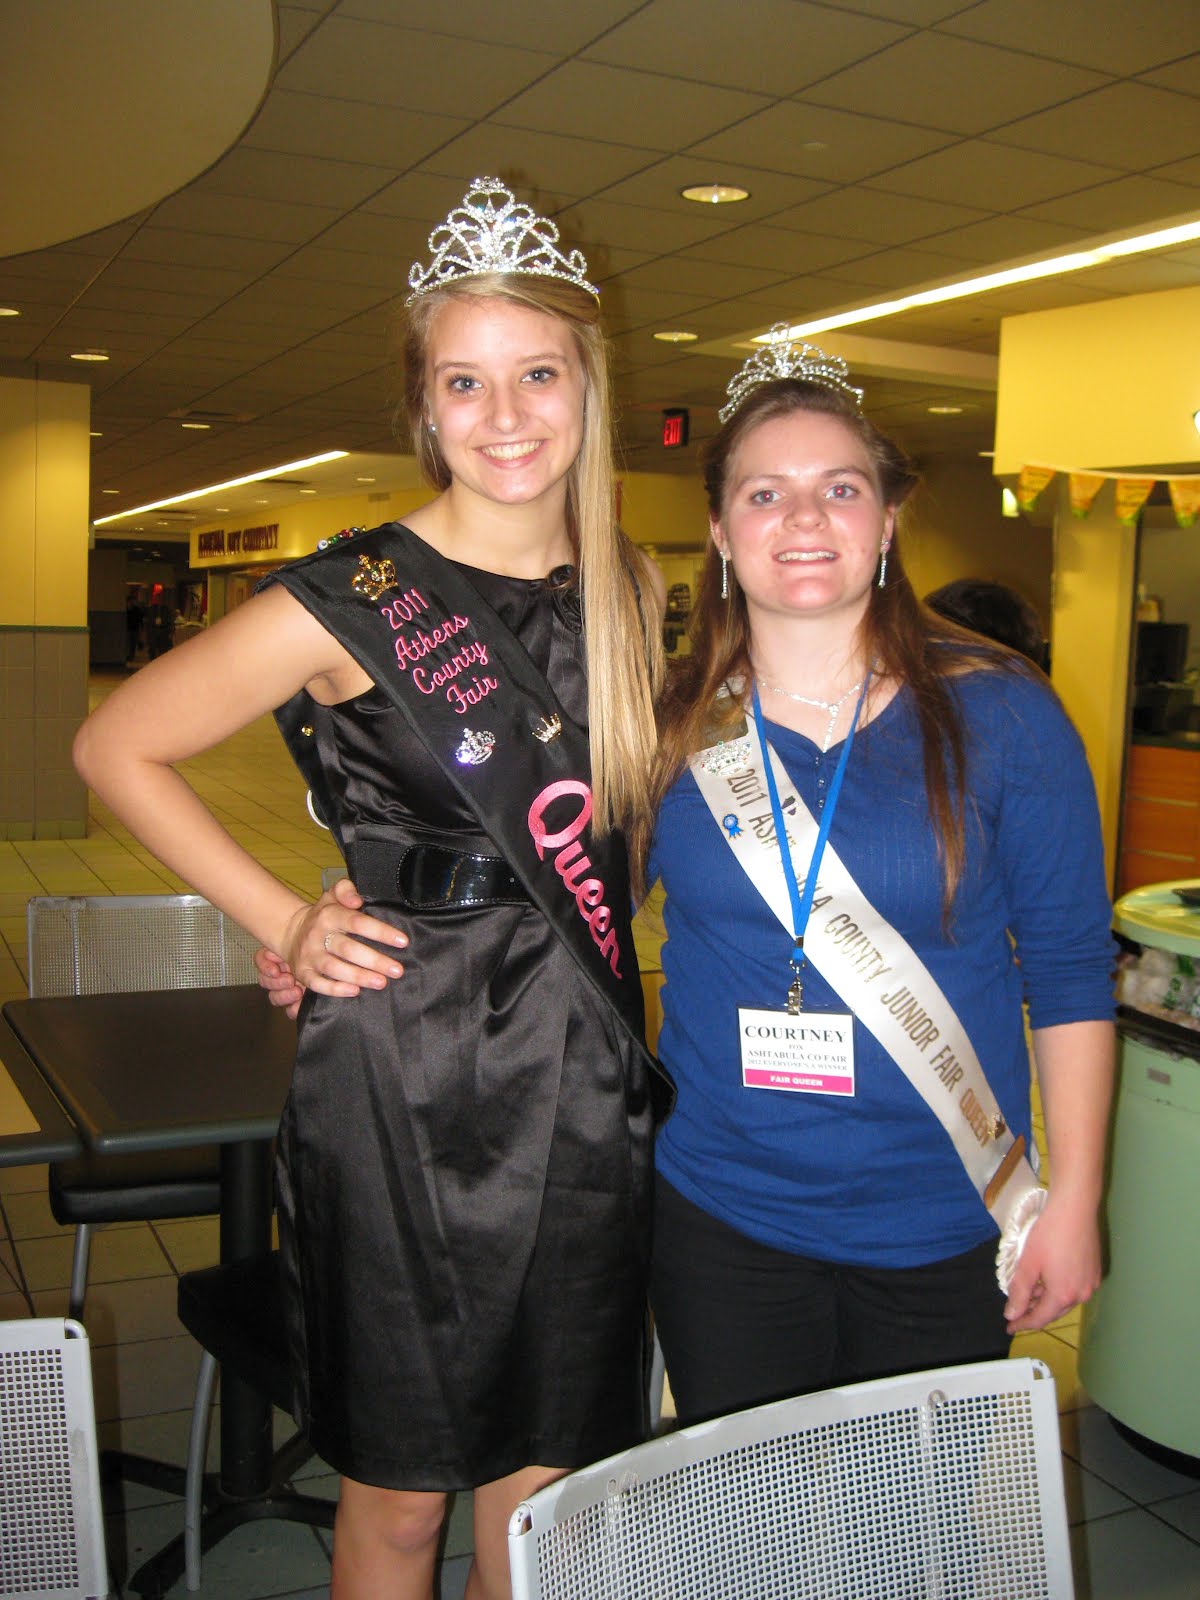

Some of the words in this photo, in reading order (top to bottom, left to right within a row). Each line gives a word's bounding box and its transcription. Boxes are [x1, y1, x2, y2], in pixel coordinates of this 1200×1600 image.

[381, 588, 429, 630] 2011
[394, 615, 469, 670] Athens
[412, 641, 489, 695] County
[446, 675, 498, 714] Fair
[527, 779, 623, 980] Queen
[726, 768, 768, 808] 2011
[824, 913, 892, 983] COUNTY
[880, 986, 940, 1053] JUNIOR
[929, 1044, 964, 1093] FAIR
[959, 1087, 991, 1148] QUEEN
[744, 1025, 847, 1043] COURTNEY
[788, 1043, 804, 1051] FOX
[747, 1050, 805, 1061] ASHTABULA
[807, 1053, 822, 1062] CO
[824, 1054, 847, 1063] FAIR
[770, 1075, 790, 1084] FAIR
[792, 1077, 823, 1087] QUEEN
